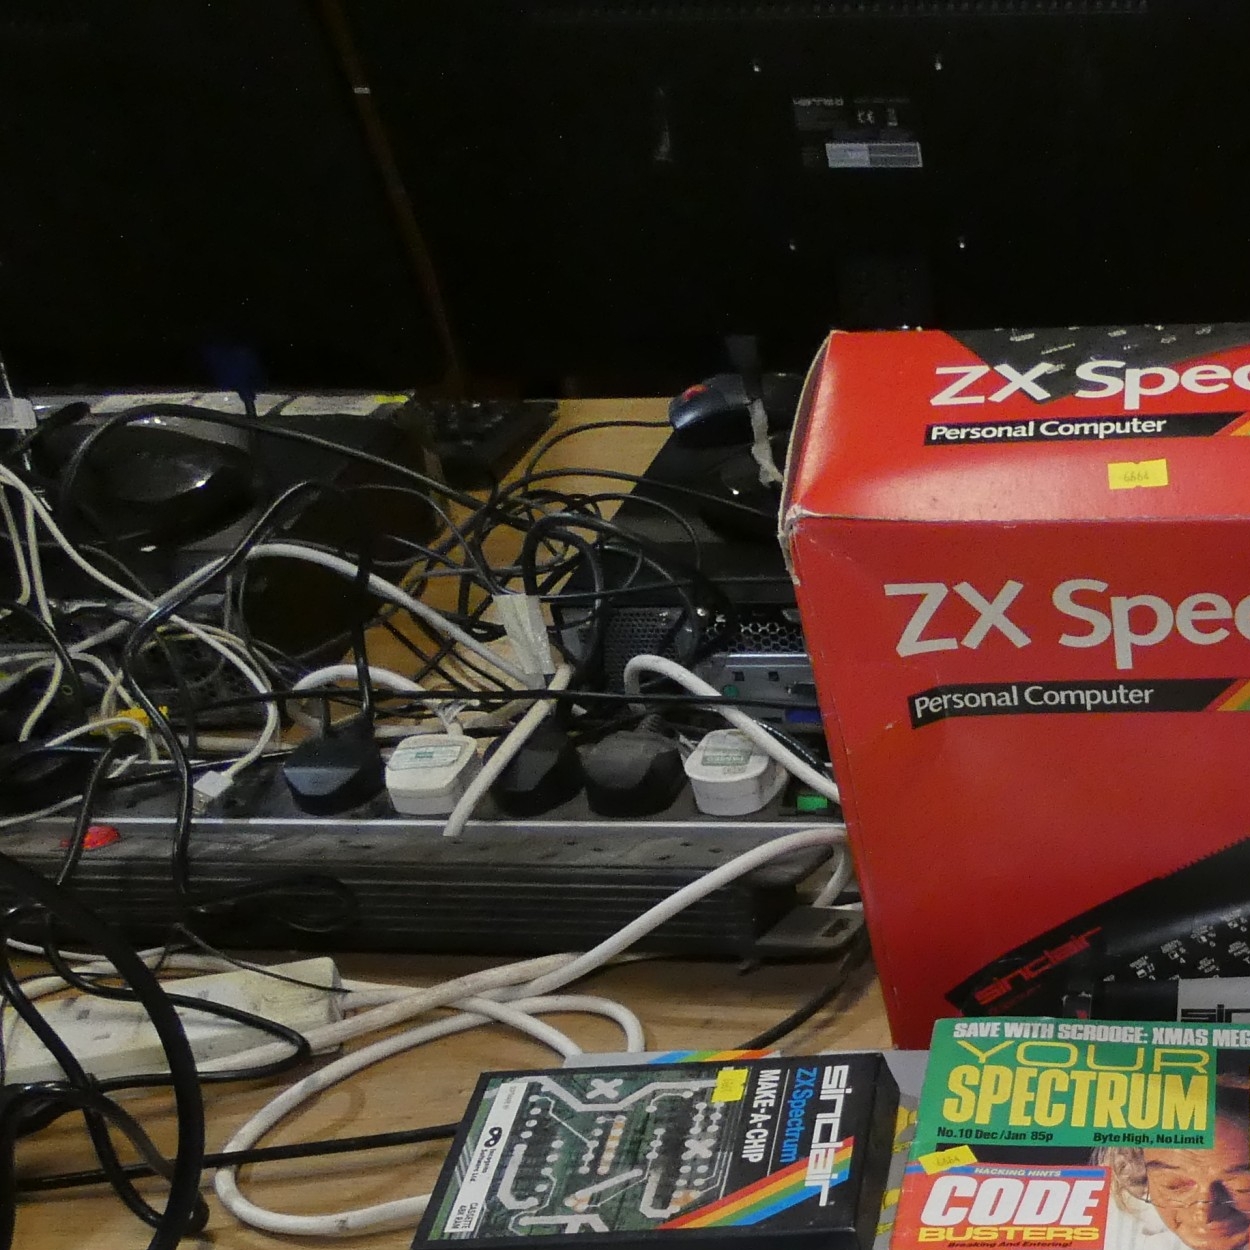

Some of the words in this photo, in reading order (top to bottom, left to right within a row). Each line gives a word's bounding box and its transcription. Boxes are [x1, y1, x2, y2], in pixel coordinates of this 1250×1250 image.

[930, 362, 1052, 406] ZX
[930, 418, 1035, 441] Personal
[1039, 416, 1167, 439] Computer
[884, 579, 1032, 658] ZX
[914, 685, 1019, 719] Personal
[1024, 683, 1155, 711] Computer
[974, 927, 1102, 1005] sinclair
[953, 1022, 1001, 1038] SAVE
[1004, 1023, 1053, 1040] WITH
[1059, 1025, 1148, 1043] SCROOGE:
[1152, 1028, 1208, 1046] XMAS
[957, 1040, 1209, 1073] YOUR
[795, 1067, 818, 1088] ZX
[942, 1064, 1207, 1131] SPECTRUM
[741, 1069, 781, 1163] MAKE-A-CHIP
[780, 1089, 814, 1163] Spectrum
[805, 1065, 852, 1206] sinclair
[937, 1127, 972, 1138] No.10
[1031, 1131, 1053, 1141] 85p
[1093, 1133, 1120, 1143] Byte
[1122, 1133, 1154, 1144] High,
[1156, 1134, 1172, 1143] No
[1174, 1135, 1204, 1144] Limit
[974, 1168, 1025, 1176] HACKING
[1028, 1169, 1062, 1177] HINTS
[462, 1203, 478, 1228] CASSETTE
[920, 1175, 1105, 1226] CODE
[918, 1226, 1099, 1242] BUSTERS
[948, 1241, 997, 1249] Breaking
